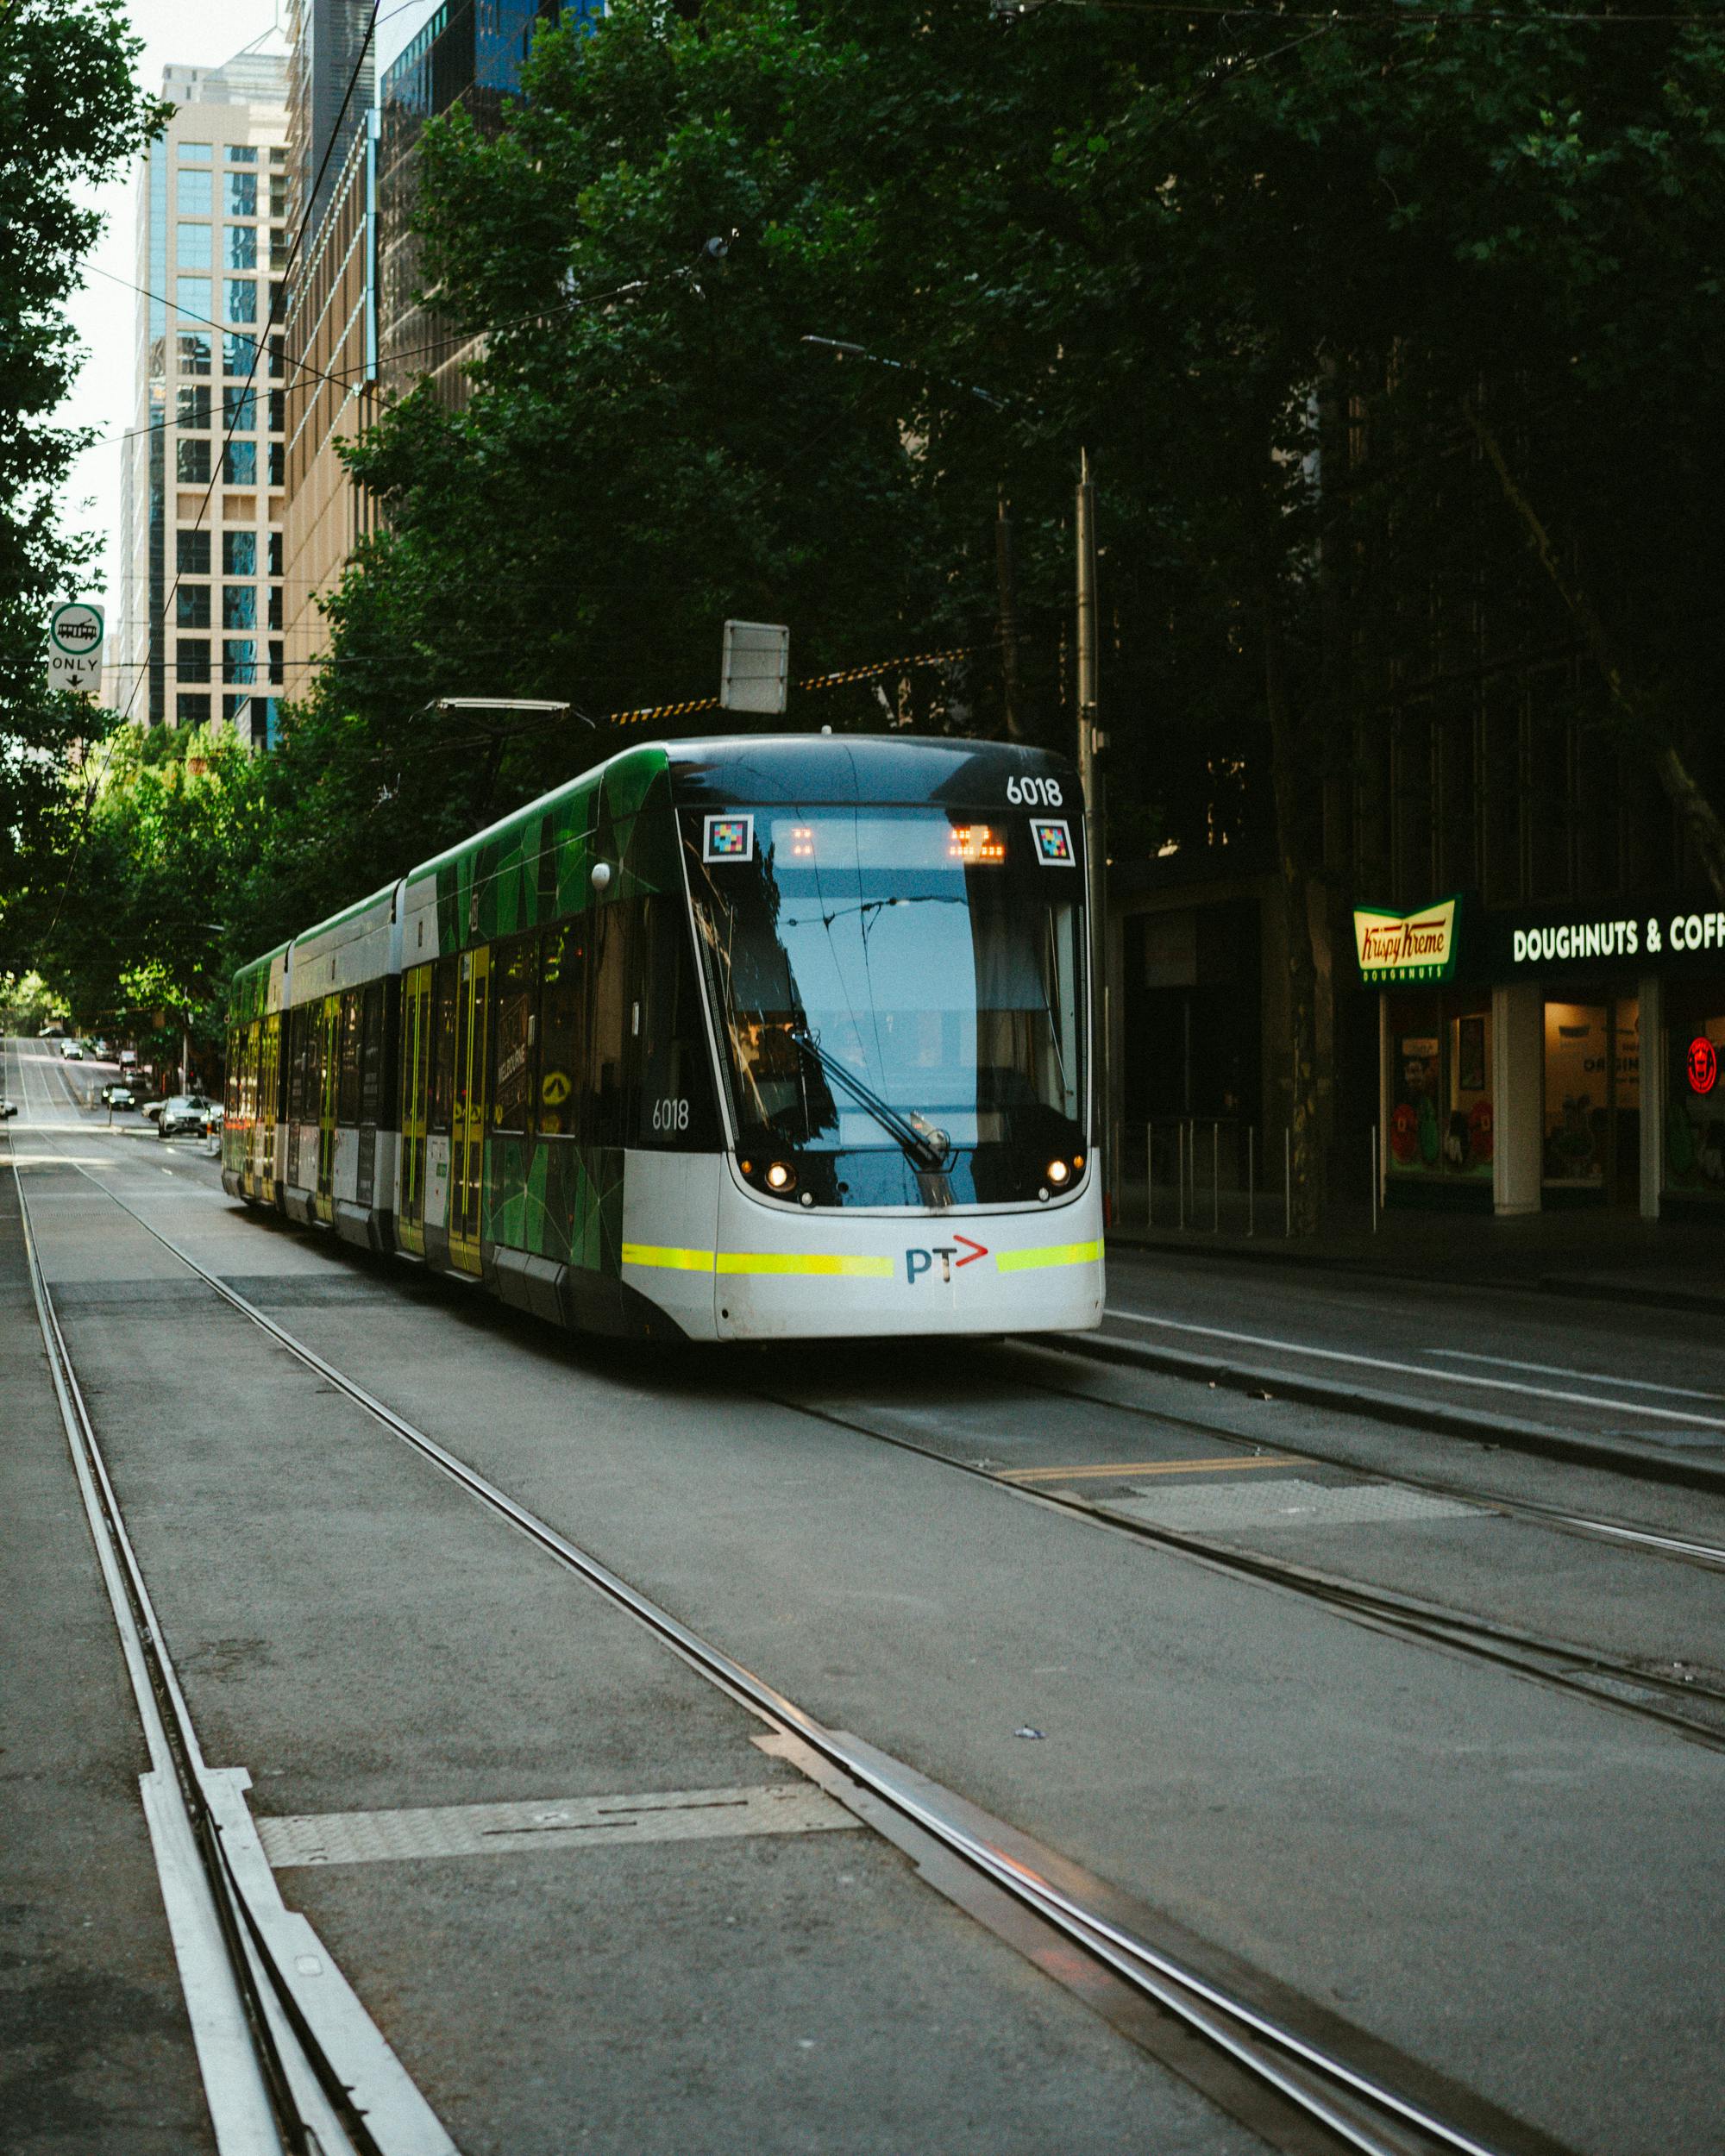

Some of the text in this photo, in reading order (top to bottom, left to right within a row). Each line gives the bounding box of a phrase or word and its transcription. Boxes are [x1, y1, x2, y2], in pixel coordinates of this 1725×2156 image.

[53, 657, 97, 671] ONLY
[1007, 775, 1063, 807] 6018
[1362, 918, 1446, 965] Krispy Kreme
[1514, 919, 1639, 962] DOUGHNUTS
[1647, 918, 1662, 953] &
[1363, 965, 1442, 981] DOUGHNUTS
[652, 1098, 689, 1131] 6018
